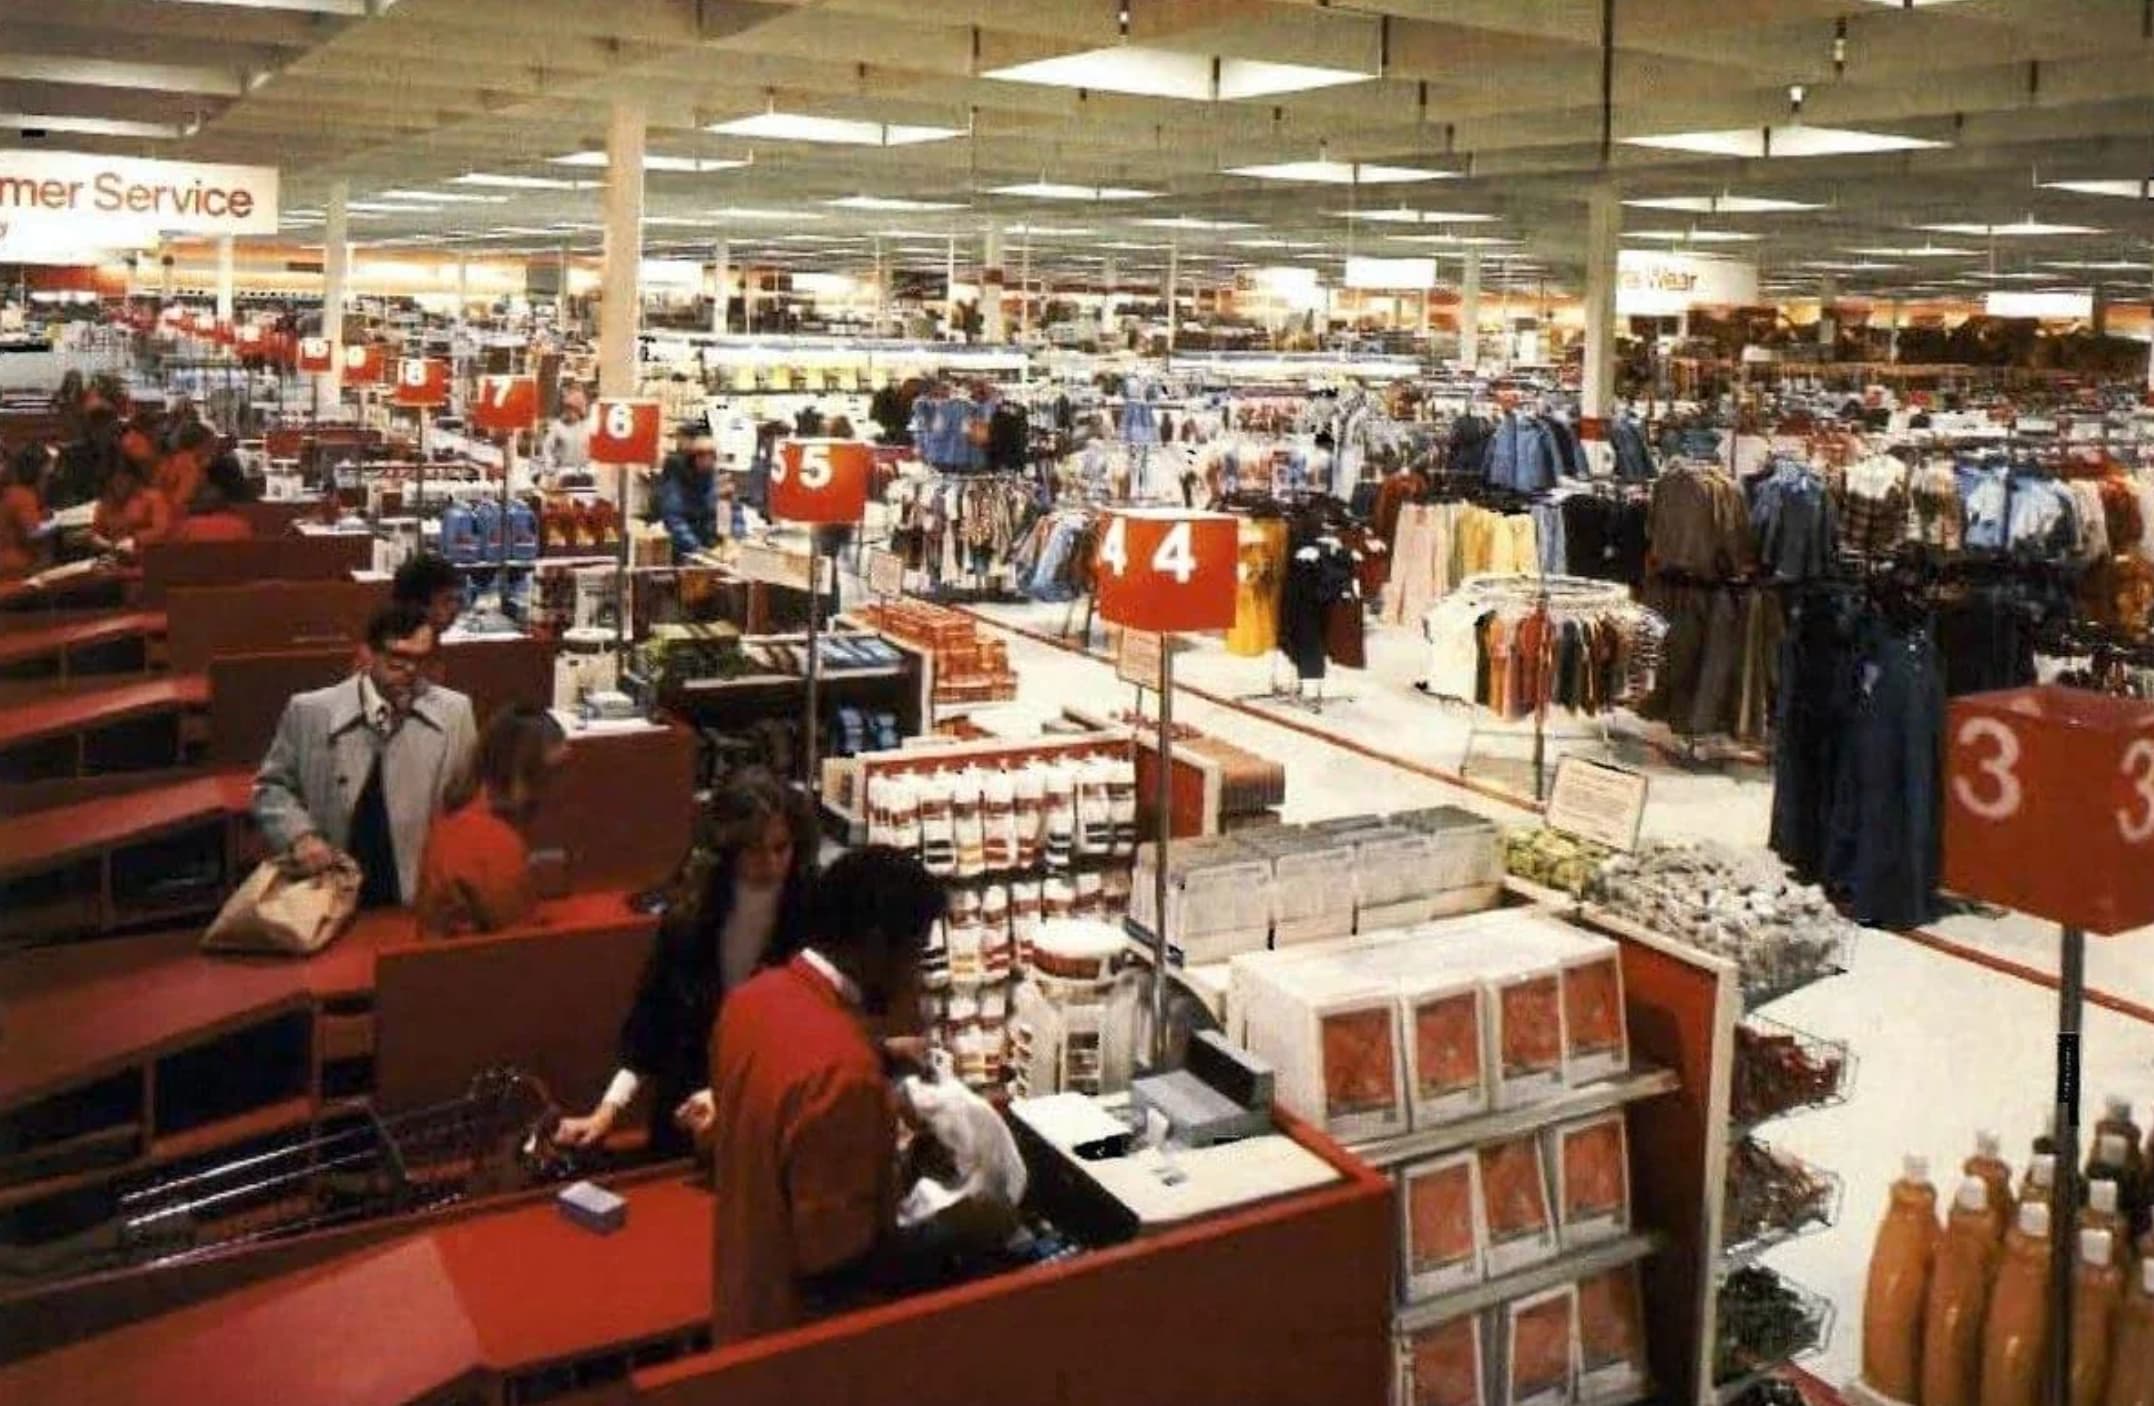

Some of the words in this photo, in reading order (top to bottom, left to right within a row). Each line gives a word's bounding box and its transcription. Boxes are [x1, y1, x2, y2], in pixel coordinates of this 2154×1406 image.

[94, 172, 254, 218] Service
[491, 375, 513, 408] 7
[607, 403, 634, 440] 6
[799, 445, 833, 489] 5
[1152, 521, 1197, 584] 4
[1954, 716, 2021, 820] 3
